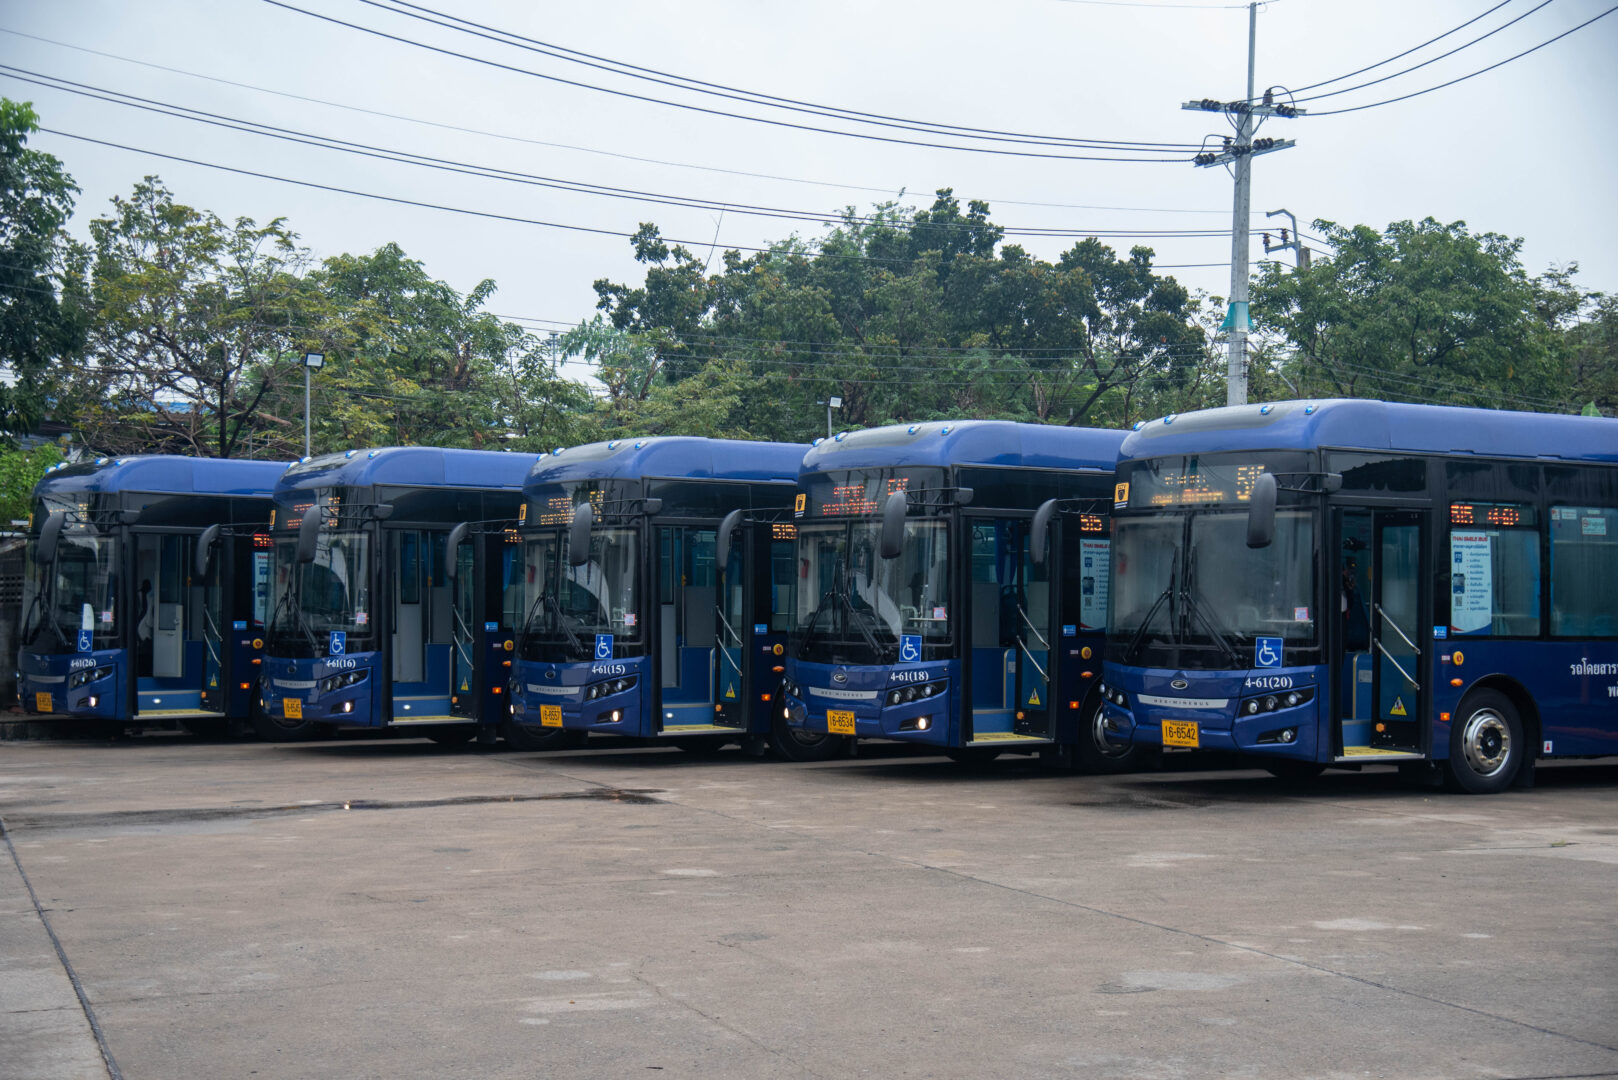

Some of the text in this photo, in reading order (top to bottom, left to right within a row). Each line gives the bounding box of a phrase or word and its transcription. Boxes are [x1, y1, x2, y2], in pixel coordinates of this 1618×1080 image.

[326, 658, 356, 669] 4-61(16)
[591, 664, 626, 675] 4-61(15)
[1570, 657, 1618, 675] รถโดยสาร
[890, 671, 929, 682] 4-61(18)
[1245, 676, 1293, 689] 4-61(20)
[829, 715, 854, 728] 16-6534
[1165, 725, 1197, 740] 16-6542
